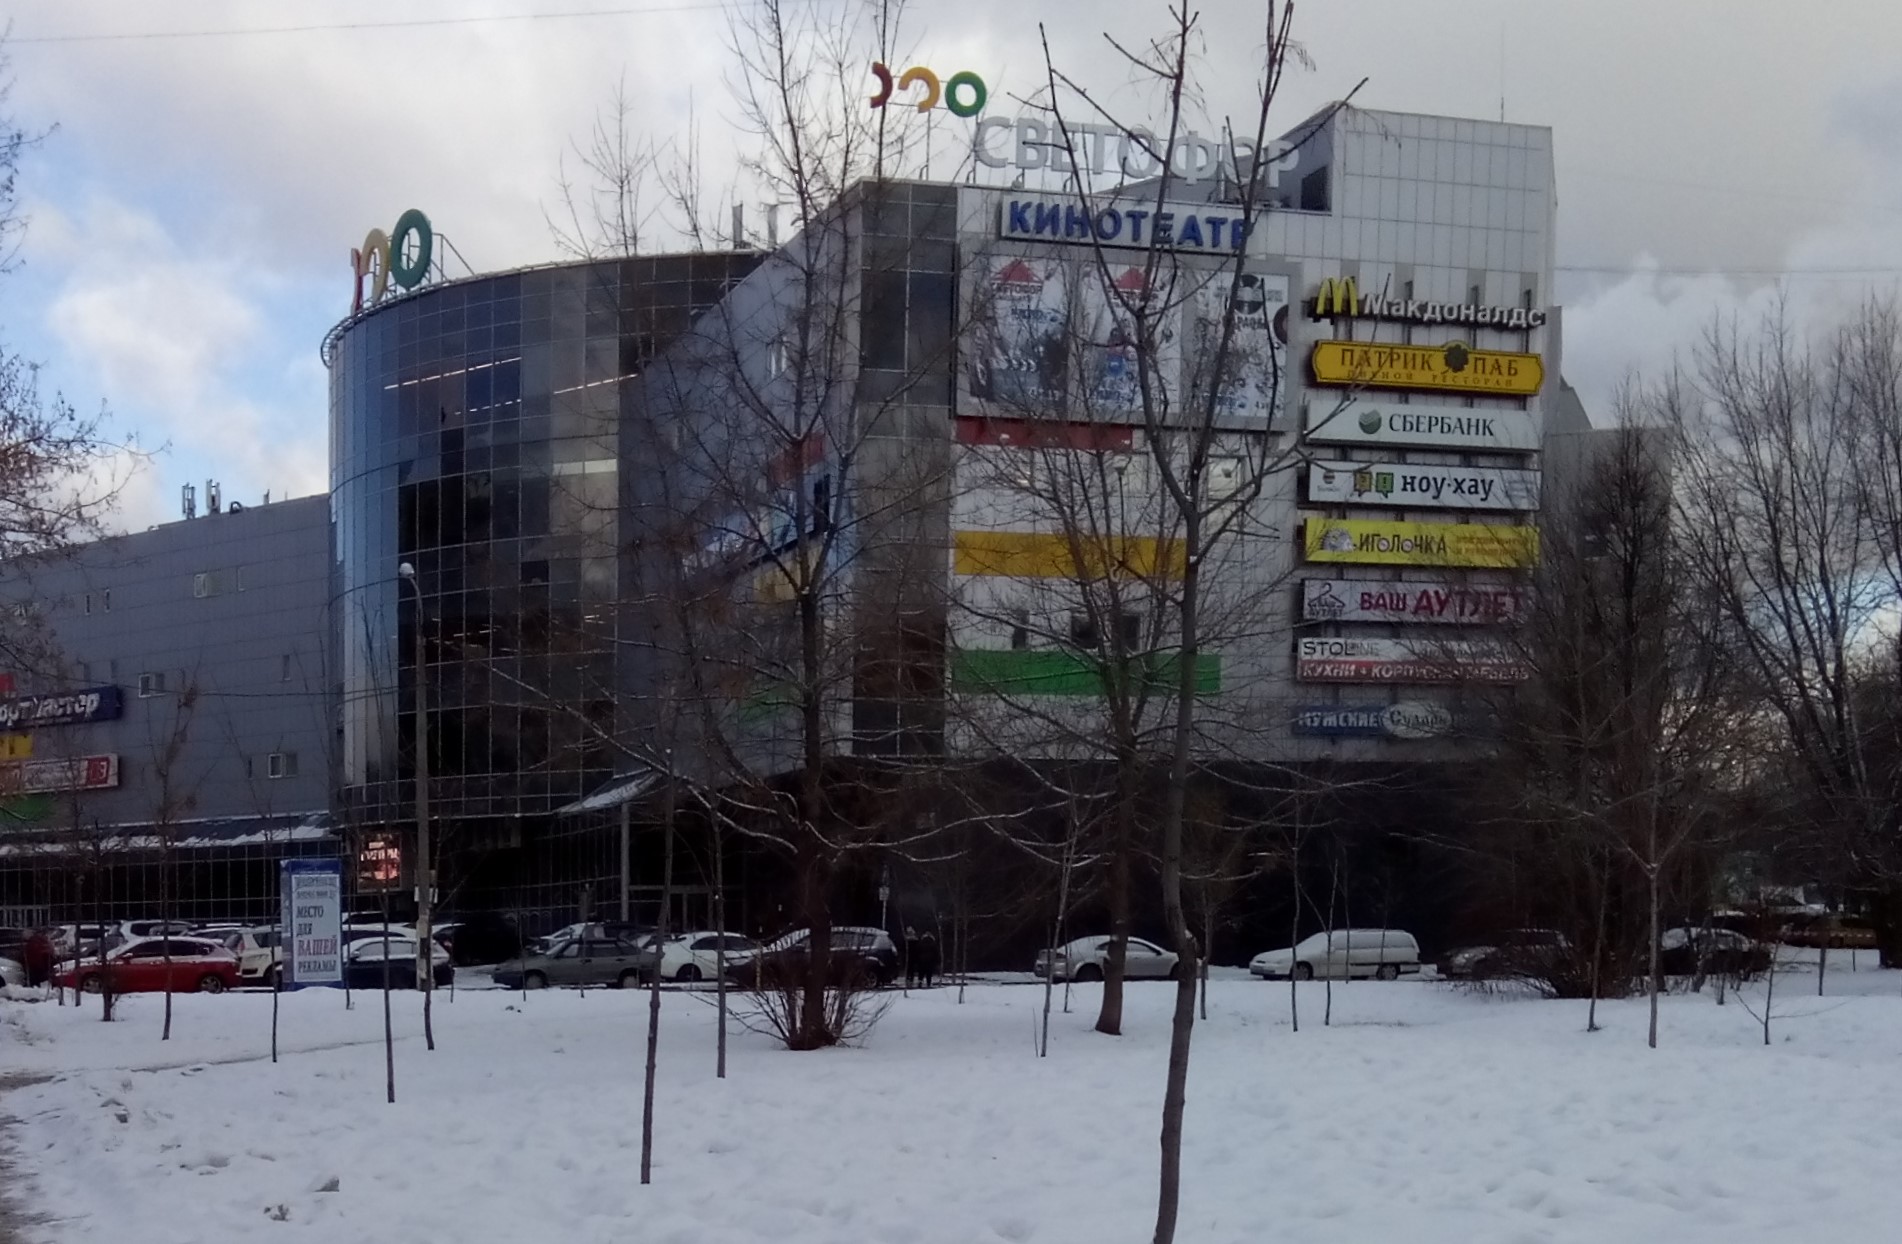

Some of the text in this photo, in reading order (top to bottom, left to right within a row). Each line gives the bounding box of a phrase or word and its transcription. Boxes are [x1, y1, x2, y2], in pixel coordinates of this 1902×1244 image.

[974, 116, 1300, 188] СВЕТОФОР
[1009, 200, 1249, 250] КИНОТЕАТР
[1363, 292, 1545, 328] Макдоналдс
[1340, 348, 1519, 377] ПАТРИК ПАБ
[1388, 413, 1495, 437] СБЕРБАНК
[1360, 591, 1407, 611] ВАШ
[1371, 664, 1462, 679] КОРПУС
[296, 905, 324, 918] МЕСТО
[298, 935, 337, 956] ВАШЕЙ
